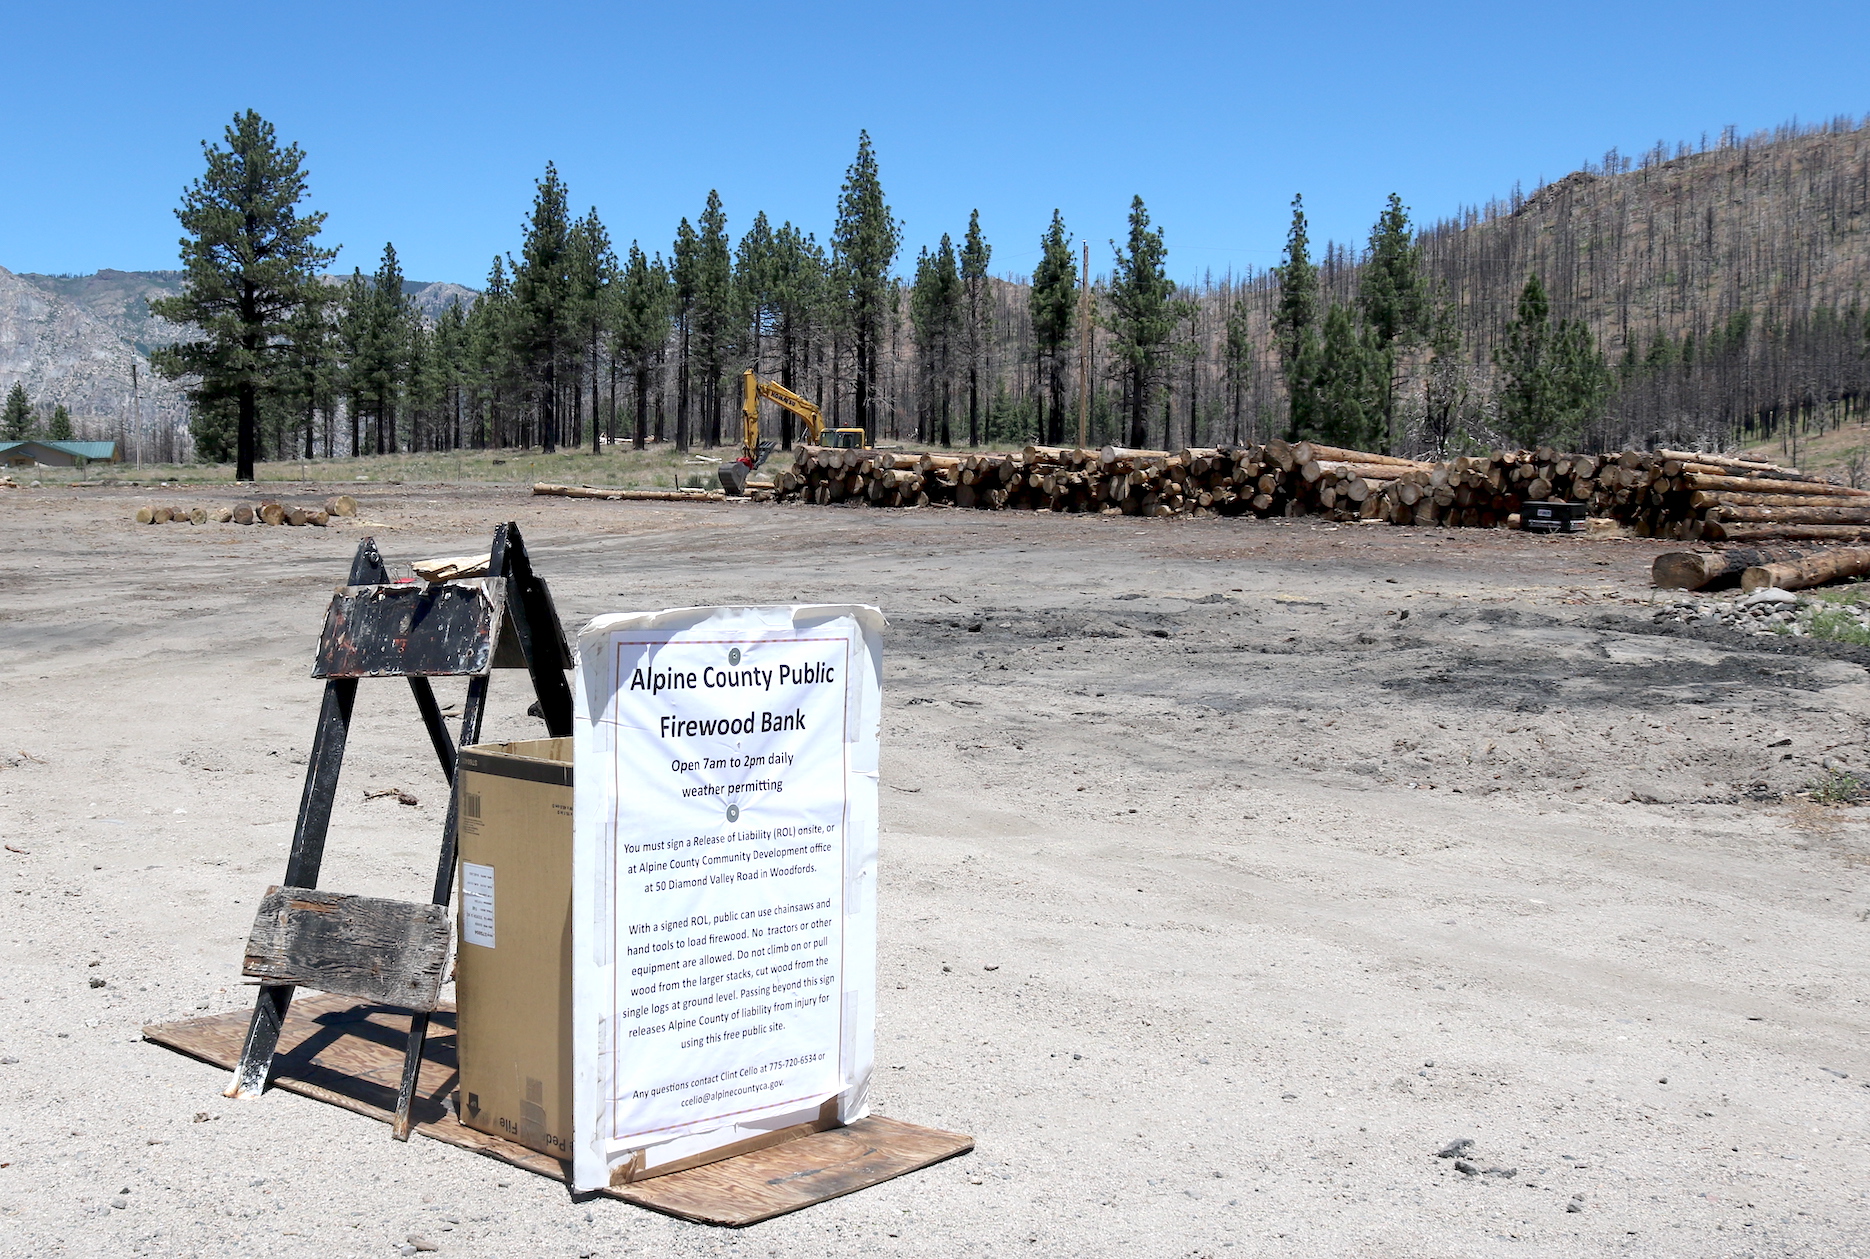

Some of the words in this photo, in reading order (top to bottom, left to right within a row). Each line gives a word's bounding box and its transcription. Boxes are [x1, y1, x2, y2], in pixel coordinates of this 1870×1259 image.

[630, 666, 697, 696] Alpine
[703, 665, 773, 692] County
[779, 661, 835, 685] Public
[660, 711, 755, 738] Firewood
[761, 708, 806, 733] Bank
[671, 759, 700, 774] Open
[703, 757, 727, 770] 7am
[729, 757, 741, 768] to
[743, 755, 765, 770] 2pm
[768, 751, 794, 766] daily
[682, 782, 724, 798] weather
[728, 778, 783, 796] permitting
[624, 843, 640, 854] You
[642, 841, 665, 852] must
[667, 838, 684, 851] sign
[686, 839, 691, 847] a
[693, 835, 725, 846] Release
[727, 831, 736, 843] of
[737, 829, 772, 841] Liability
[773, 826, 796, 840] (ROL)
[797, 824, 825, 836] onsite,
[826, 824, 835, 833] or
[627, 864, 637, 874] at
[639, 861, 668, 874] Alpine
[669, 858, 700, 869] County
[702, 851, 751, 866] Community
[753, 845, 808, 860] Development
[809, 842, 832, 854] office
[644, 883, 653, 893] at
[656, 880, 667, 892] 50
[668, 875, 708, 890] Diamond
[709, 873, 735, 885] Valley
[736, 869, 759, 881] Road
[760, 869, 768, 878] in
[769, 863, 817, 877] Woodfords.
[628, 922, 651, 935] With
[653, 924, 658, 932] a
[660, 917, 689, 933] signed
[691, 915, 711, 926] ROL,
[713, 911, 738, 926] public
[740, 910, 756, 920] can
[757, 908, 772, 917] use
[774, 902, 814, 915] chainsaws
[816, 898, 831, 909] and
[627, 943, 650, 956] hand
[652, 940, 674, 953] tools
[676, 940, 685, 949] to
[687, 934, 707, 947] load
[709, 929, 749, 944] firewood.
[752, 928, 764, 937] No
[767, 924, 798, 936] tractors
[800, 922, 809, 931] or
[810, 918, 832, 929] other
[631, 960, 680, 977] equipment
[682, 959, 697, 968] are
[699, 951, 735, 966] allowed.
[737, 950, 749, 960] Do
[751, 947, 765, 958] not
[767, 943, 789, 955] climb
[790, 943, 802, 951] on
[803, 941, 811, 950] or
[813, 936, 828, 950] pull
[630, 983, 656, 996] wood
[658, 981, 680, 992] from
[682, 977, 697, 988] the
[699, 974, 724, 986] larger
[726, 968, 754, 982] stacks,
[755, 966, 769, 976] cut
[770, 961, 793, 974] wood
[794, 960, 814, 969] from
[815, 956, 829, 966] the
[622, 1005, 649, 1019] single
[651, 1003, 669, 1015] logs
[671, 1000, 681, 1011] at
[682, 993, 714, 1011] ground
[716, 990, 738, 1003] level.
[740, 985, 771, 999] Passing
[772, 978, 802, 993] beyond
[803, 976, 818, 987] this
[819, 974, 835, 986] sign
[629, 1024, 666, 1038] releases
[668, 1018, 697, 1032] Alpine
[698, 1013, 729, 1026] County
[731, 1008, 740, 1020] of
[741, 1004, 772, 1018] liability
[773, 1002, 793, 1012] from
[794, 996, 817, 1009] injury
[818, 993, 830, 1003] for
[681, 1037, 704, 1049] using
[706, 1032, 722, 1044] this
[723, 1030, 740, 1041] free
[742, 1024, 767, 1040] public
[769, 1022, 785, 1032] site.
[632, 1090, 649, 1100] Any
[650, 1081, 689, 1098] questions
[690, 1074, 719, 1088] contact
[720, 1070, 738, 1081] Clint
[739, 1066, 758, 1077] Celio
[760, 1064, 767, 1073] at
[769, 1053, 817, 1071] 775-720-6534
[818, 1053, 825, 1061] or
[681, 1080, 784, 1107] ccelio@alpinecountyca.gov.
[499, 1117, 518, 1135] File
